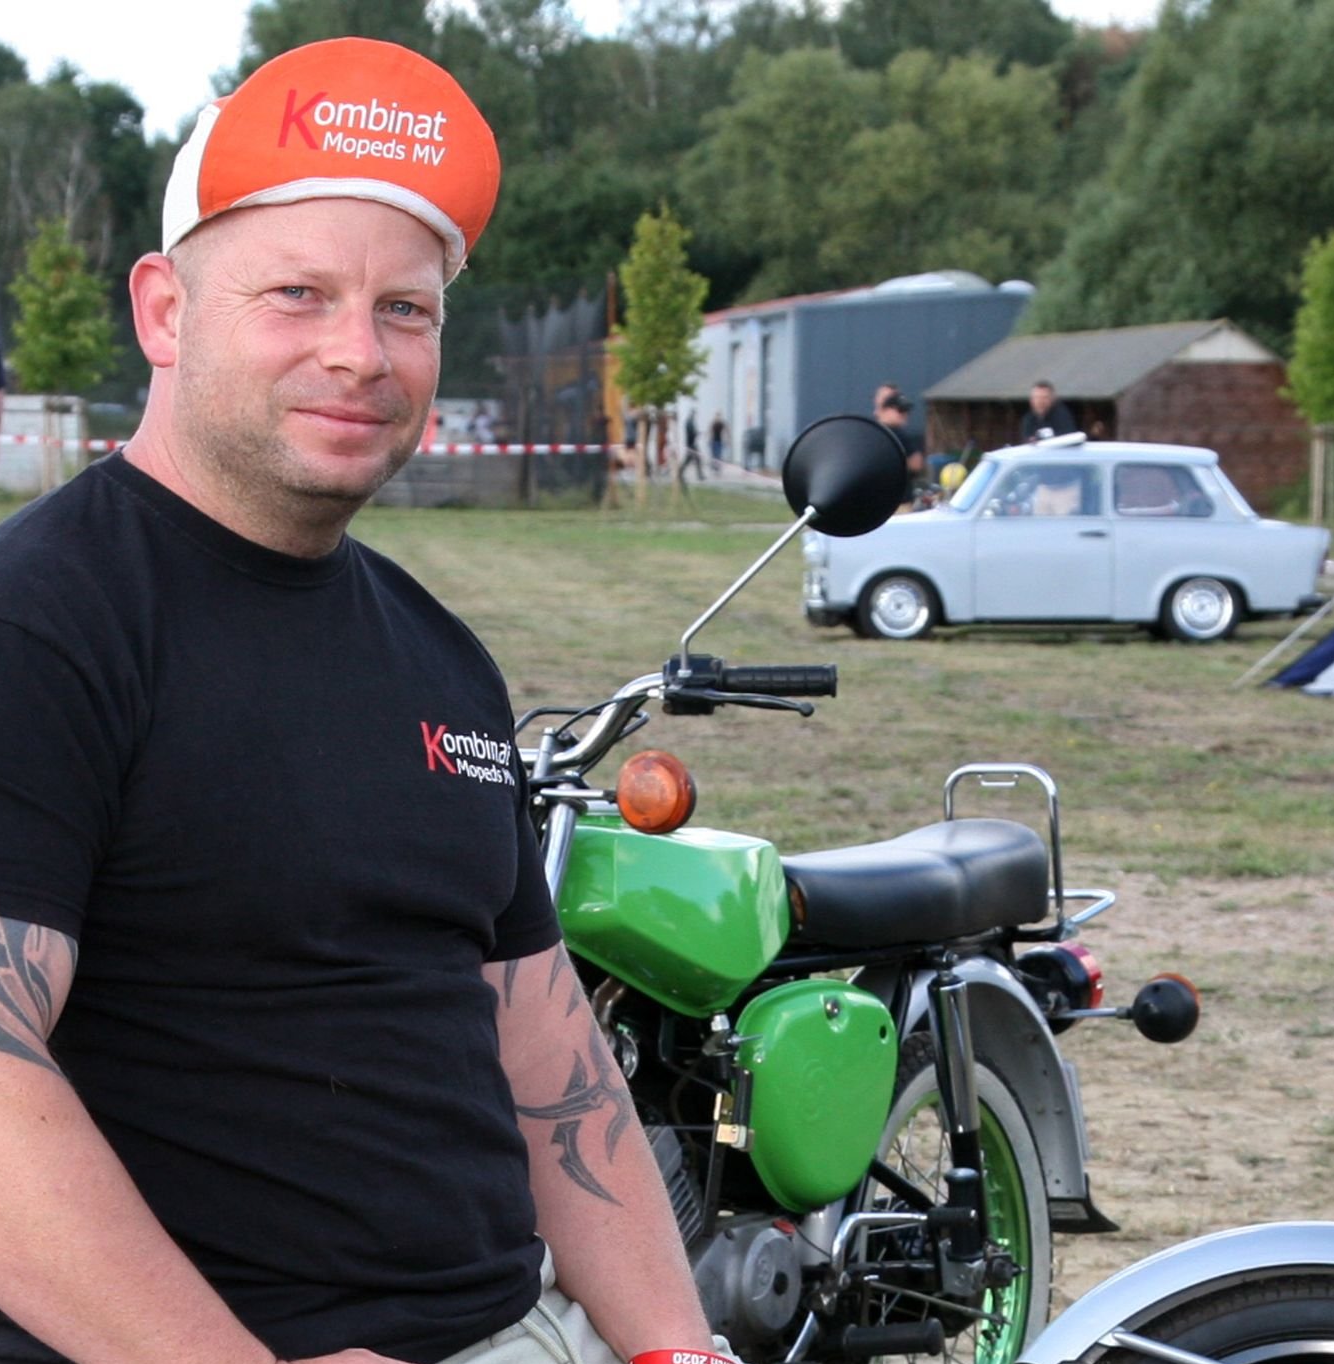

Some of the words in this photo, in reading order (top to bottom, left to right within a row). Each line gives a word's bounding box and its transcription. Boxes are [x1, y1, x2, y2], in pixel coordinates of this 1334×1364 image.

[278, 89, 447, 151] Kombinat
[323, 131, 406, 160] Mopeds
[412, 143, 446, 167] MV
[456, 758, 503, 783] Mopeds
